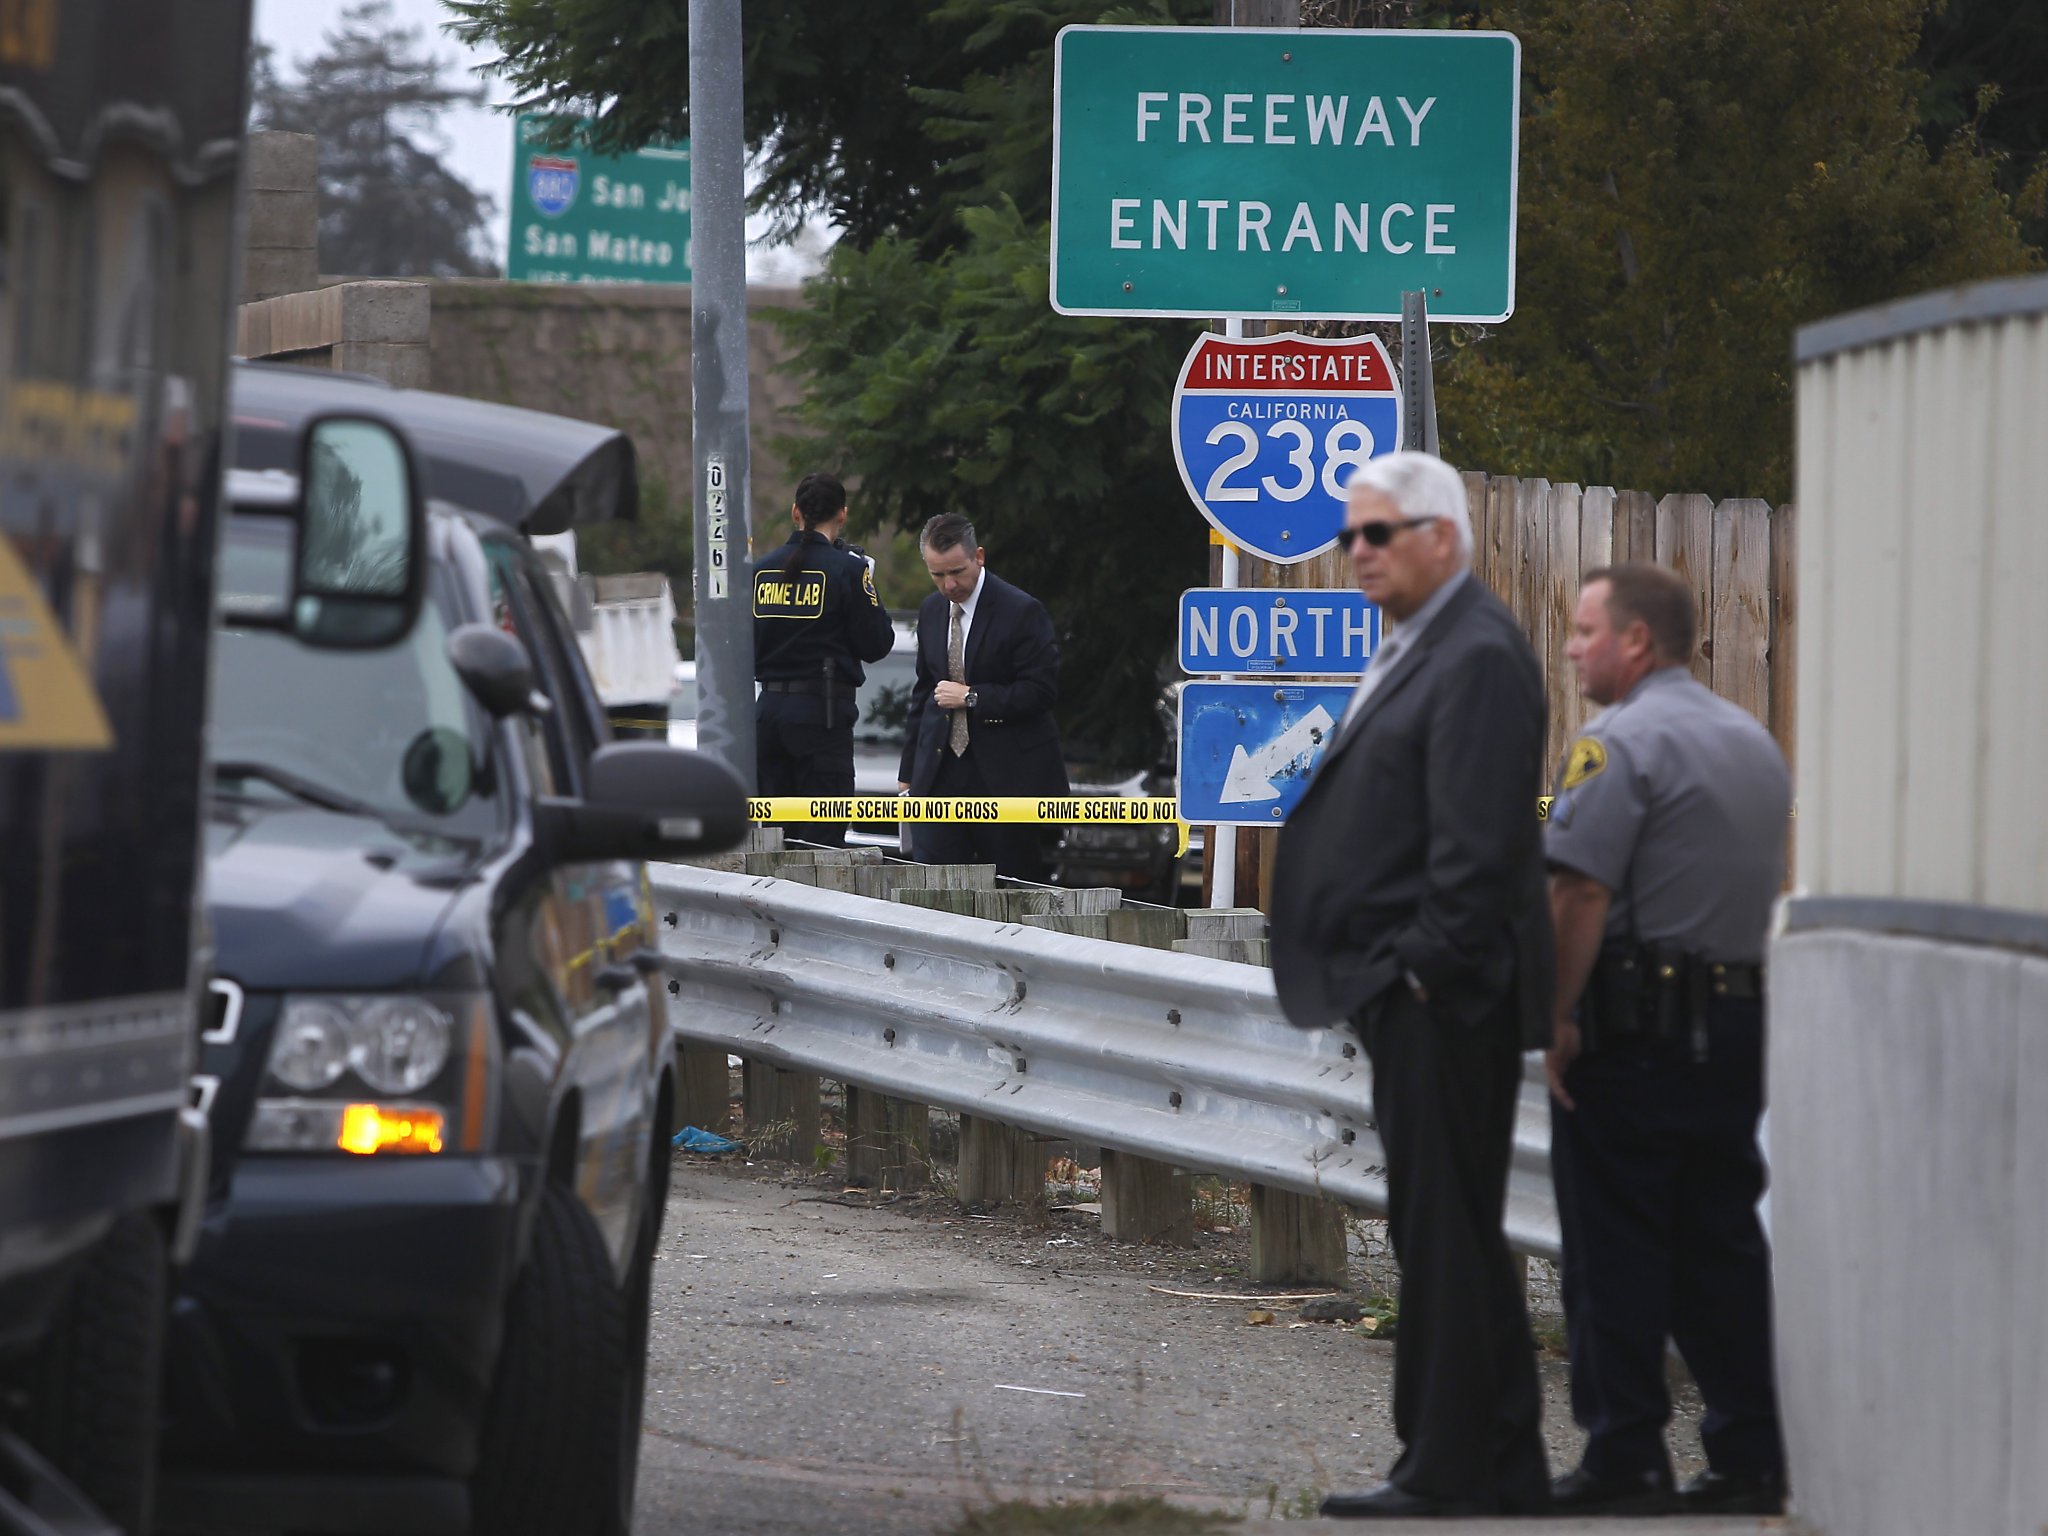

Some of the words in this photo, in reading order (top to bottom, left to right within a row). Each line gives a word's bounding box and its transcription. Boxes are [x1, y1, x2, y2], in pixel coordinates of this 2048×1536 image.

[1137, 92, 1437, 147] FREEWAY
[592, 174, 645, 209] San
[524, 224, 577, 256] San
[587, 229, 673, 267] Mateo
[1110, 199, 1456, 255] ENTRANCE
[1204, 353, 1372, 382] INTERSTATE
[1227, 402, 1349, 420] CALIFORNIA
[1204, 419, 1376, 502] 238
[758, 582, 793, 605] CRIME
[795, 583, 820, 606] LAB
[1189, 605, 1372, 658] NORTH
[810, 801, 852, 818] CRIME
[856, 801, 898, 819] SCENE
[903, 801, 921, 819] DO
[925, 801, 951, 819] NOT
[955, 802, 998, 820] CROSS
[1037, 801, 1080, 819] CRIME
[1084, 801, 1126, 820] SCENE
[1131, 801, 1148, 820] DO
[1153, 801, 1176, 820] NOT
